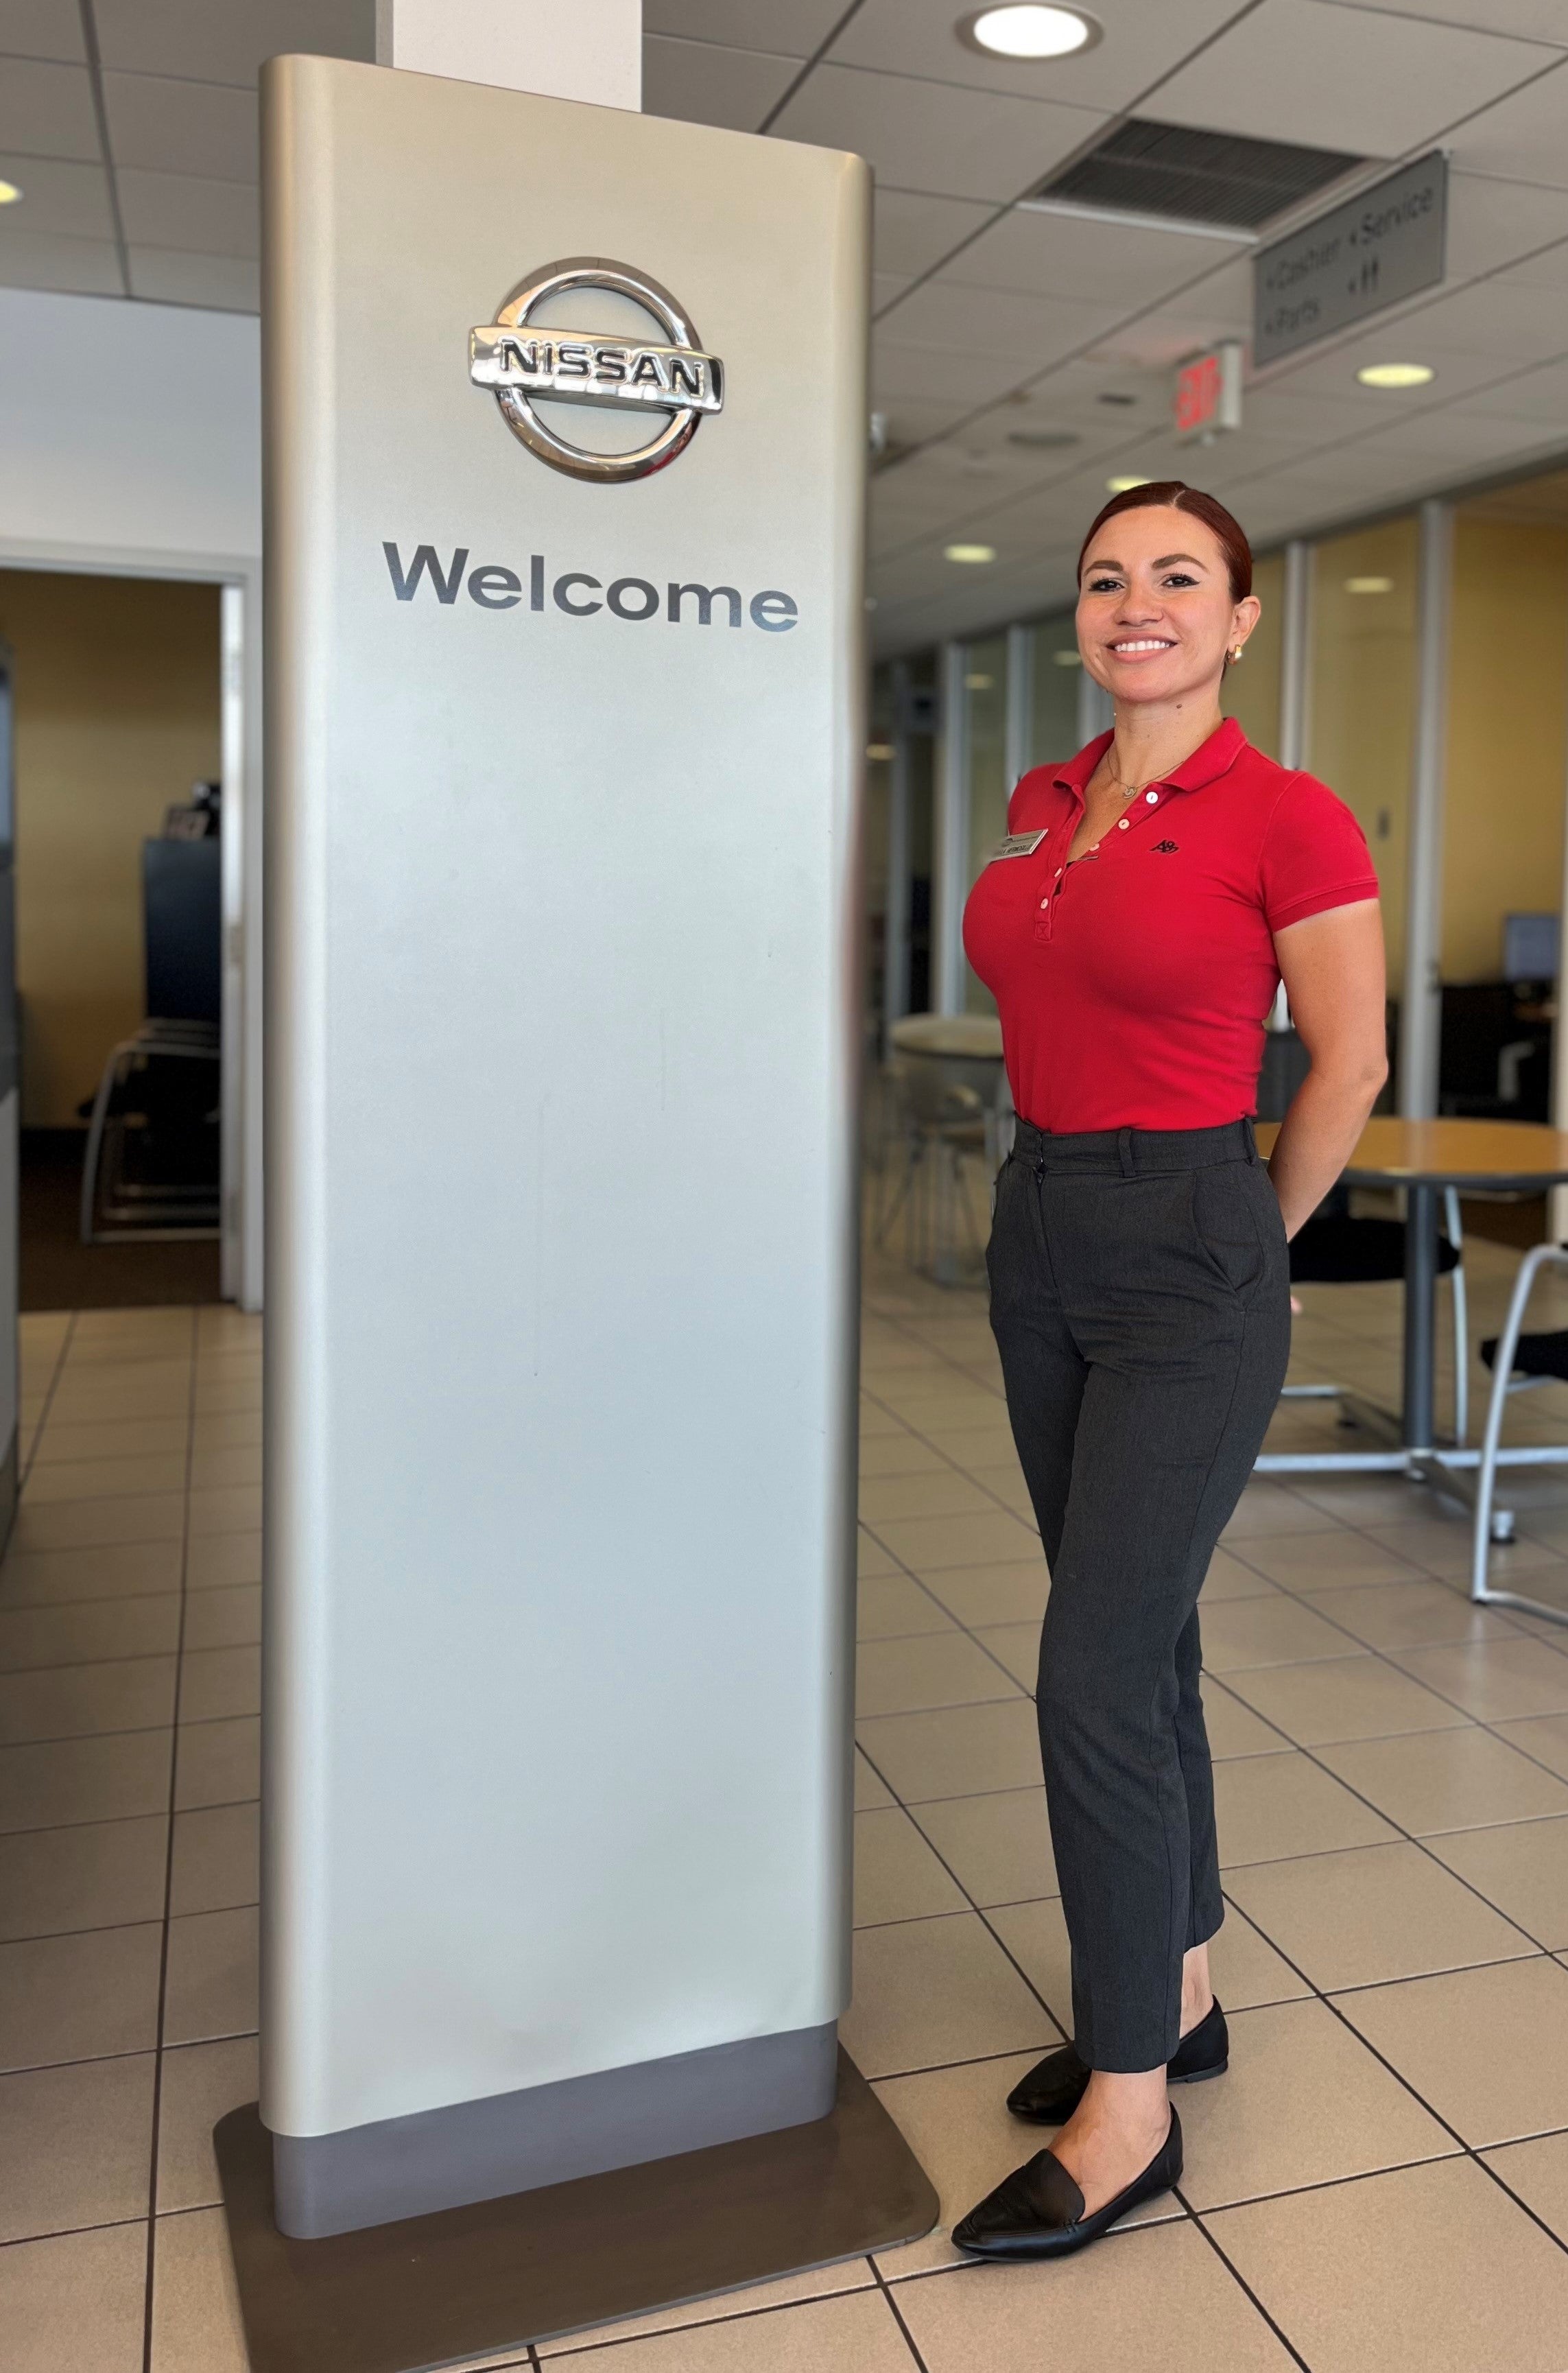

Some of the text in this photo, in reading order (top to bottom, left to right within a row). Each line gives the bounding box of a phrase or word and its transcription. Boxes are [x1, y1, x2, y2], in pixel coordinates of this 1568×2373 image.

[1361, 187, 1434, 246] Service
[499, 336, 705, 399] NISSAN
[381, 541, 798, 633] Welcome
